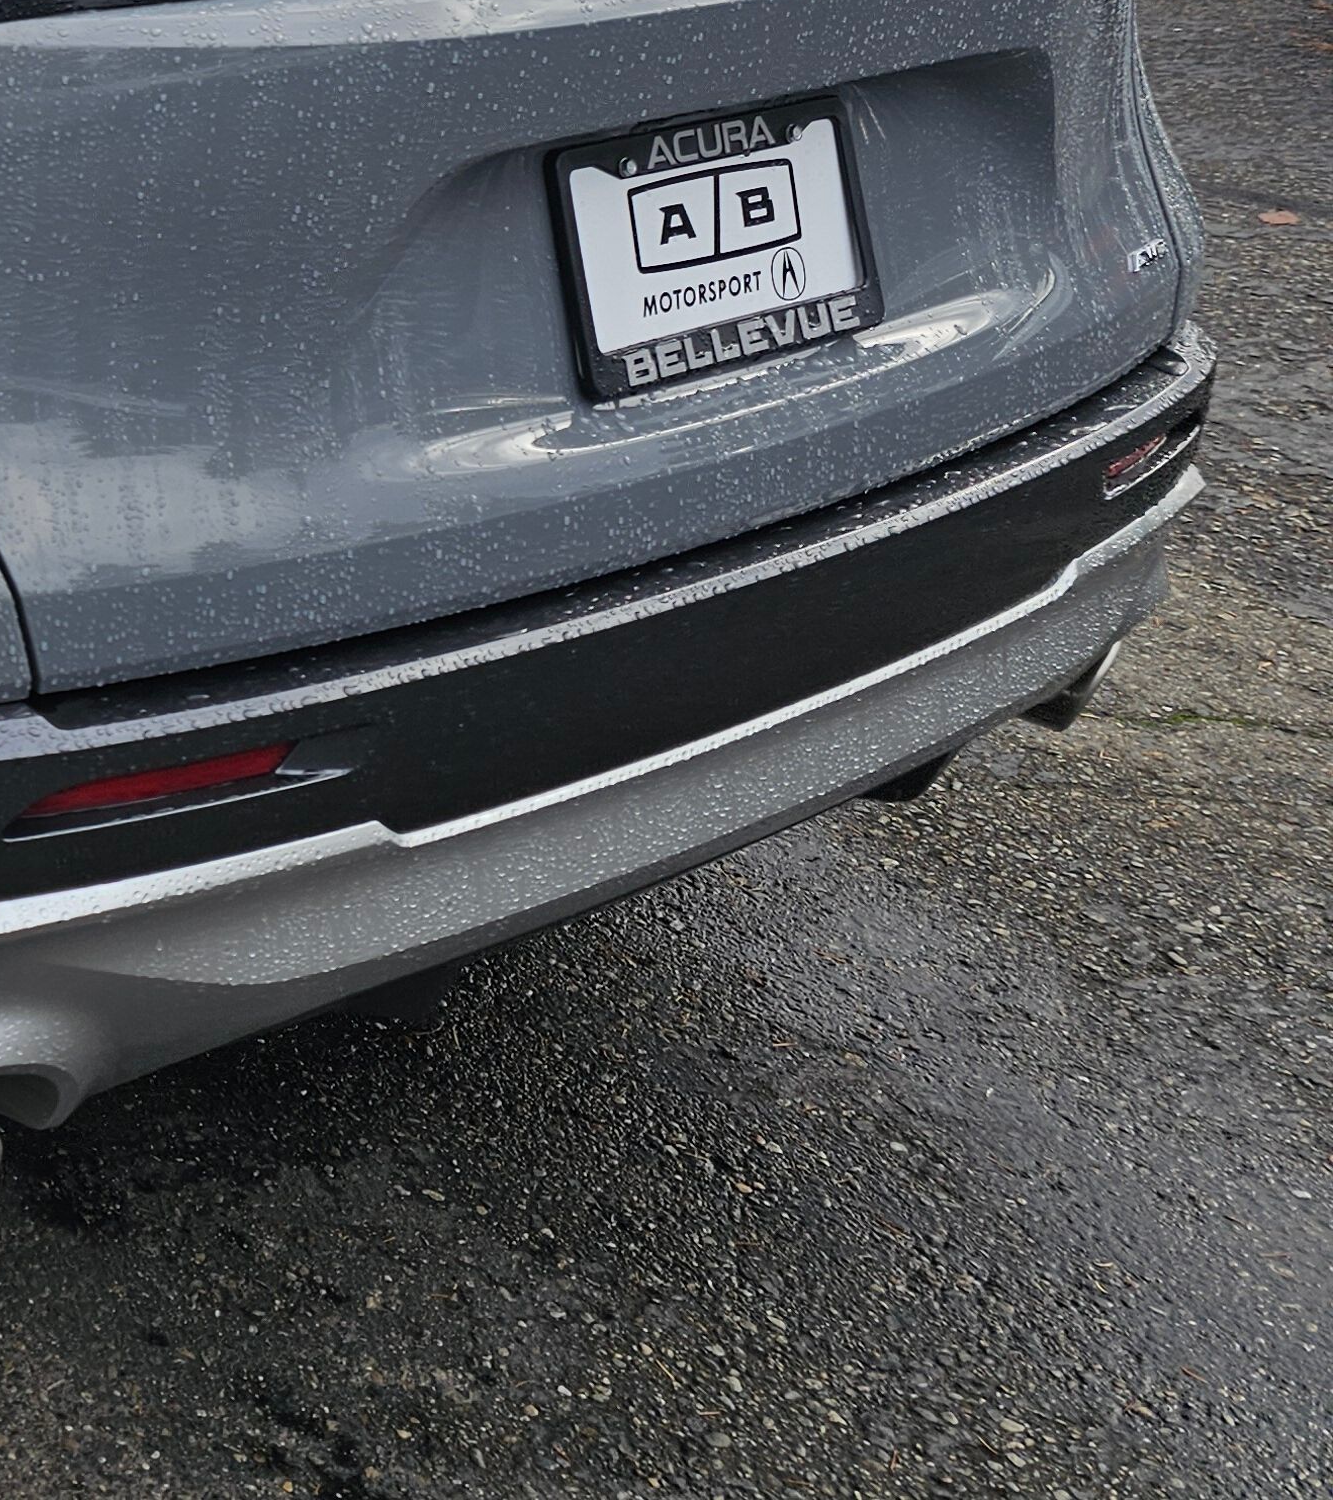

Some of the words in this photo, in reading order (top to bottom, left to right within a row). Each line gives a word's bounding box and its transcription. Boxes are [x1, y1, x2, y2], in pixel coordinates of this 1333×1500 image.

[648, 116, 776, 170] ACURA
[659, 203, 697, 246] A
[735, 186, 775, 228] B
[643, 270, 762, 318] MOTORSPORT
[621, 295, 861, 388] BELLEVUE
